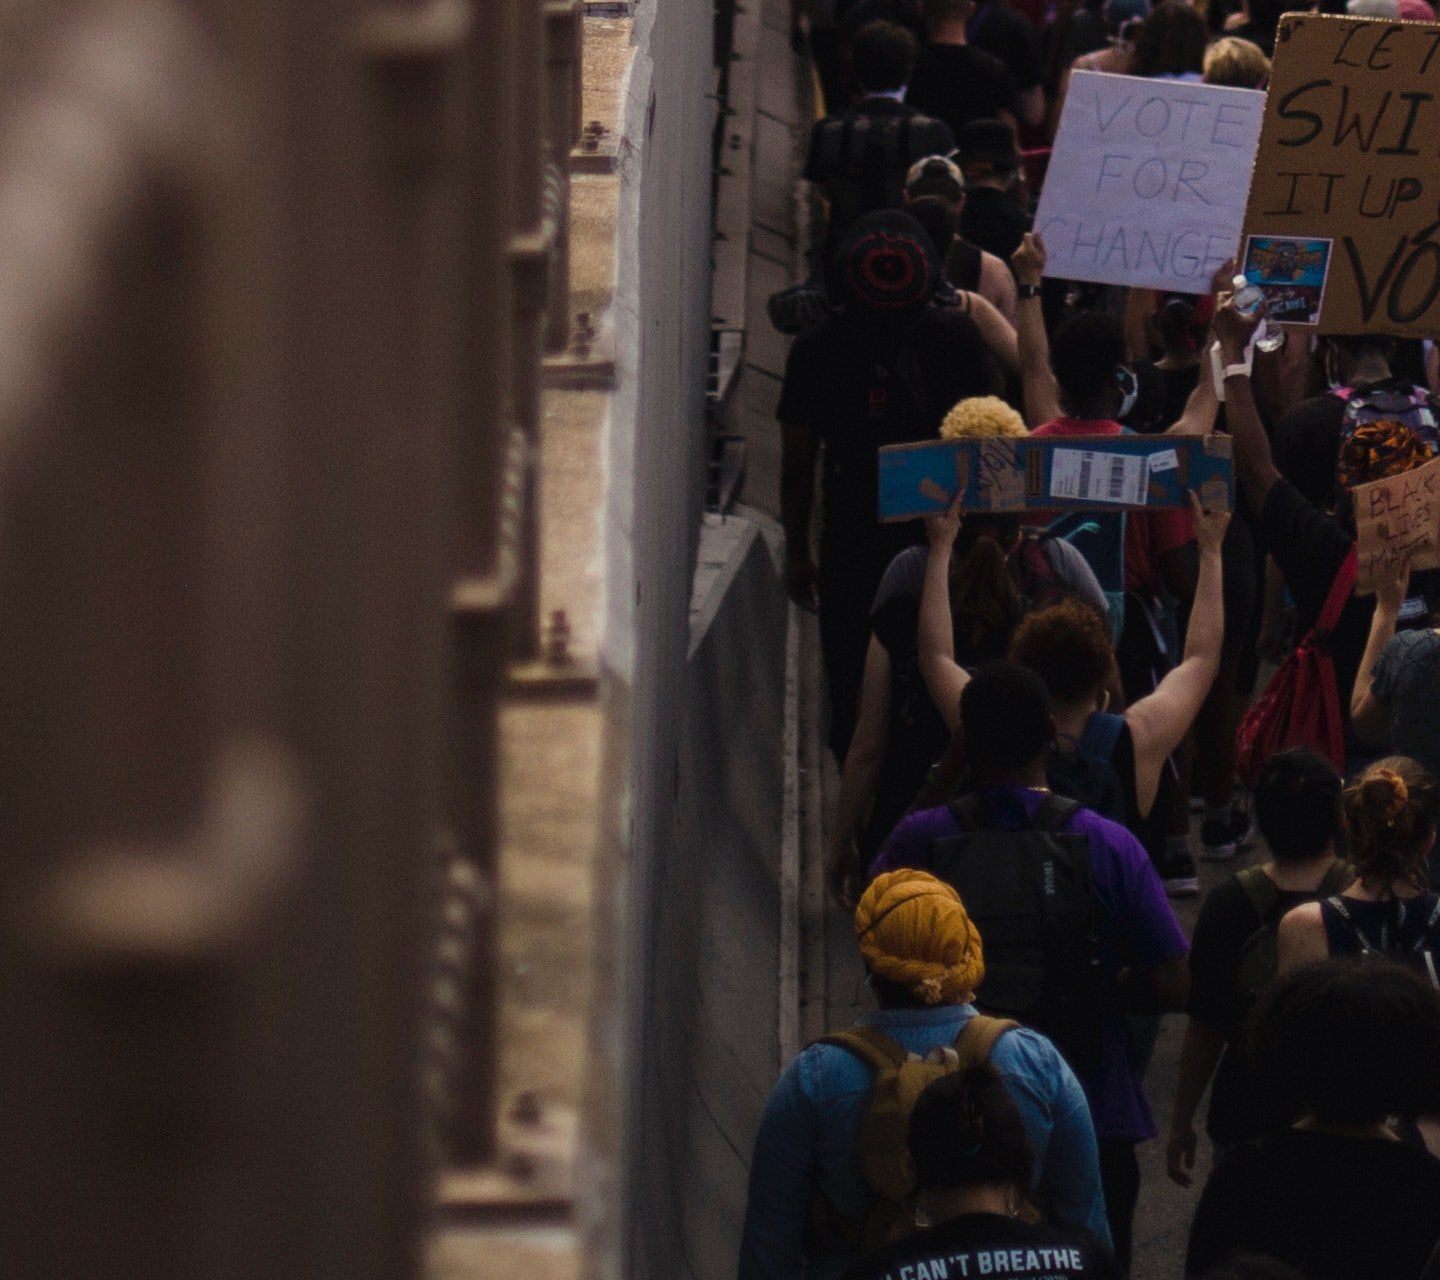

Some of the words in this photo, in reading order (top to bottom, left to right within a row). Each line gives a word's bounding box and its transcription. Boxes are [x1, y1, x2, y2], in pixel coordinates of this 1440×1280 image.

[1095, 91, 1252, 148] VOTE
[1097, 155, 1211, 206] FOR
[1263, 171, 1345, 216] IT
[1360, 174, 1423, 219] UP
[1041, 216, 1232, 280] CHANGE
[900, 1254, 969, 1280] CAN'T
[978, 1249, 1083, 1275] BREATHE
